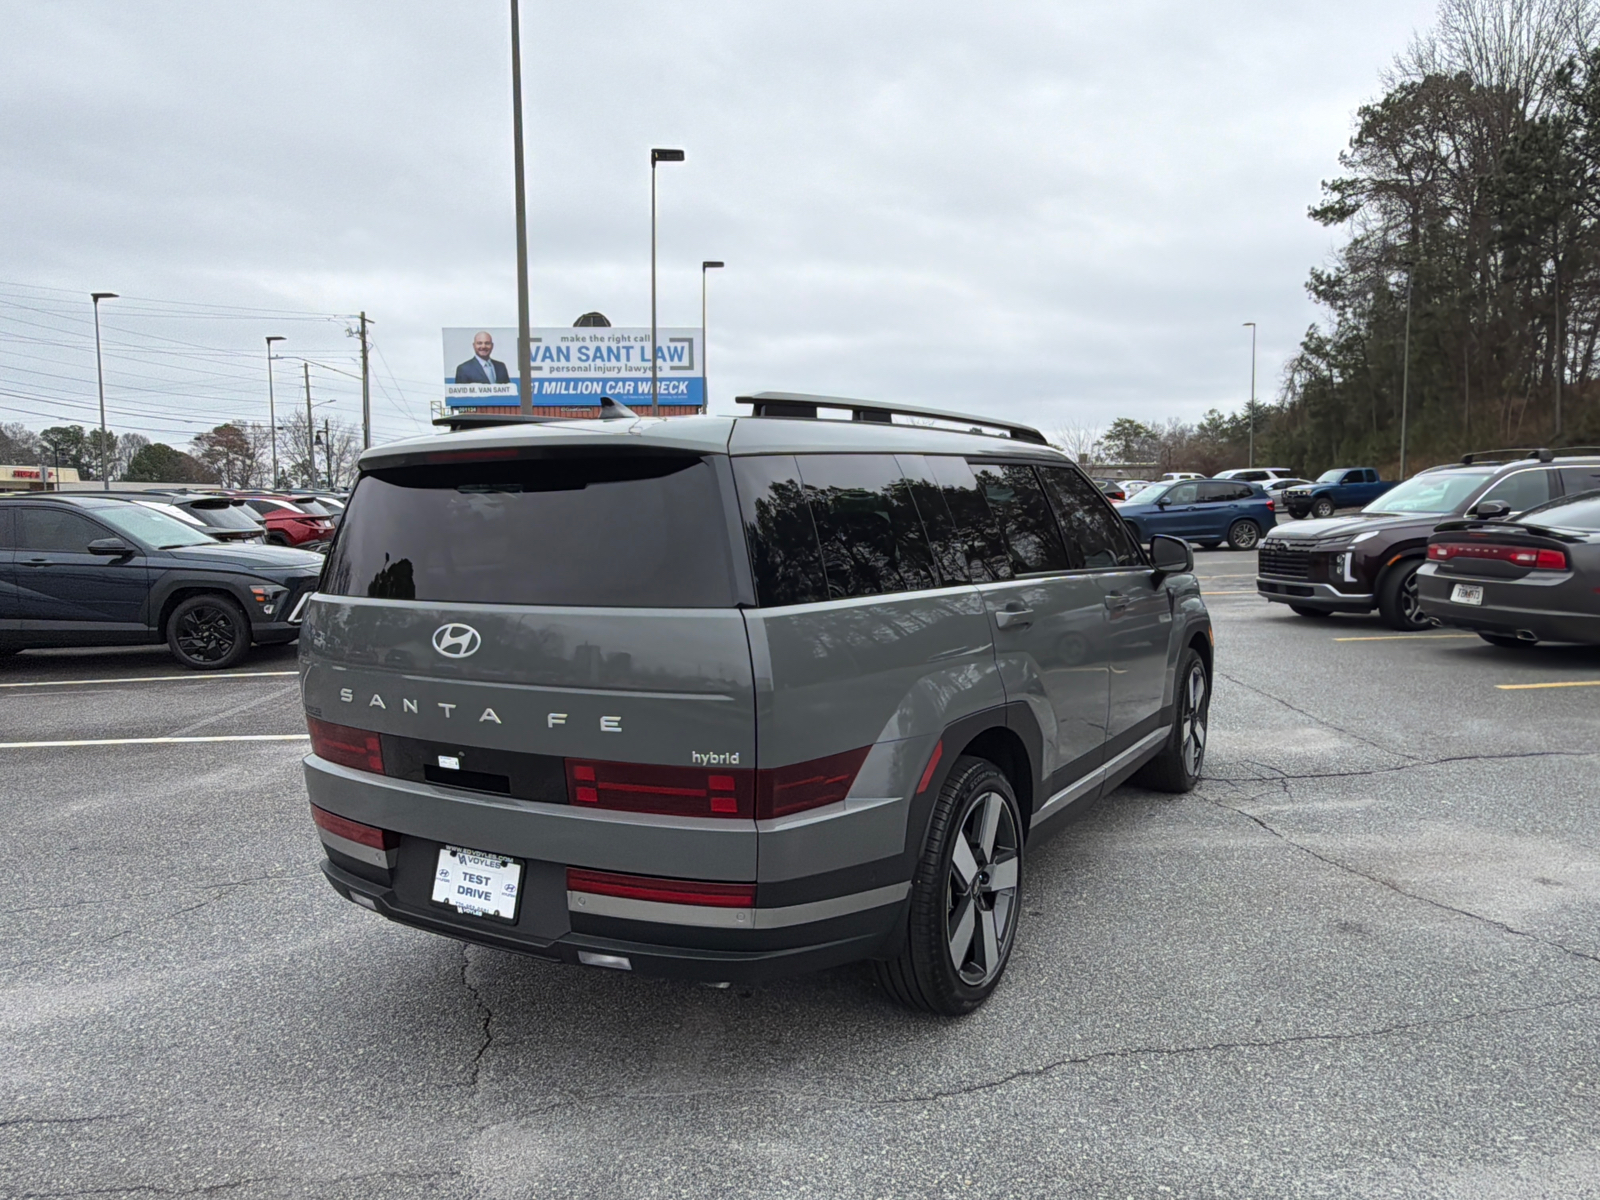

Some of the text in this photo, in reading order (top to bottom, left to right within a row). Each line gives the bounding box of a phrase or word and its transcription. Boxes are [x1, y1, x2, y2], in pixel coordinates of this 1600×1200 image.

[561, 334, 651, 345] make the right call
[530, 345, 685, 363] VAN SANT LAW
[549, 364, 663, 375] personal injury lawyes
[542, 381, 603, 395] MILLION
[605, 381, 635, 395] CAR
[340, 688, 502, 724] SANTA
[547, 713, 622, 732] FE
[692, 750, 740, 766] hybrid
[467, 856, 501, 869] VOYLES
[462, 871, 491, 887] TEST
[457, 885, 492, 901] DRIVE
